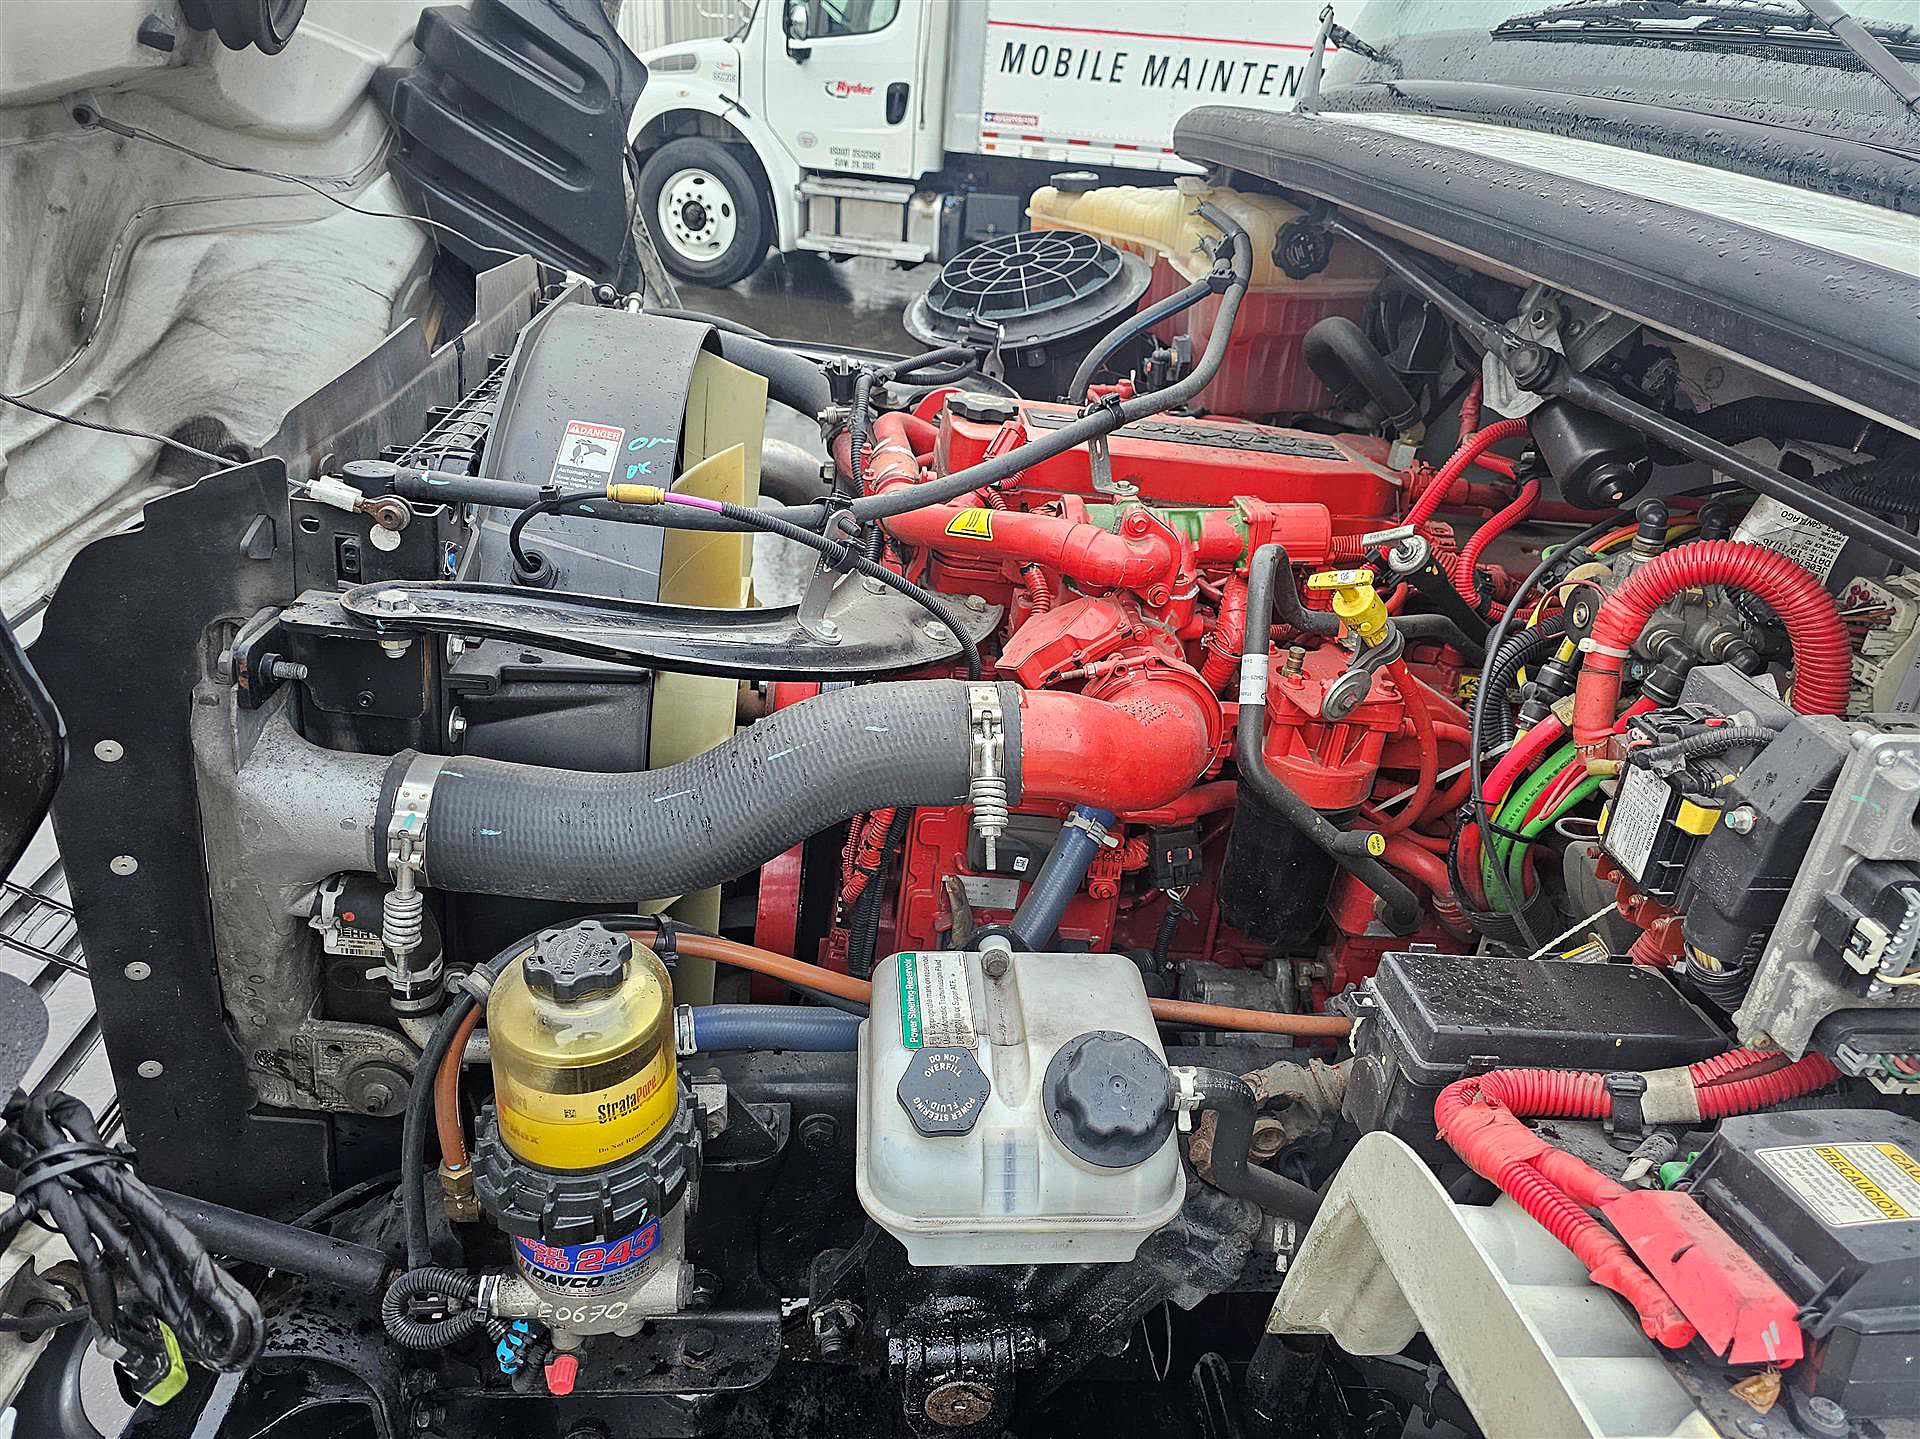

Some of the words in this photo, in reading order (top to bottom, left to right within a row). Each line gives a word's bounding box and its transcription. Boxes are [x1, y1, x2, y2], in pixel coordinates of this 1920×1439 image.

[1000, 42, 1128, 83] MOBILE
[1141, 54, 1326, 97] MAINTEN
[836, 80, 874, 96] Ryder
[580, 427, 620, 441] DANGER
[558, 467, 590, 477] Automatic
[1781, 511, 1822, 530] SANTIAGO
[1652, 814, 1661, 831] MAIN
[903, 959, 915, 989] Reservoir
[936, 972, 946, 1005] Transmission
[905, 991, 918, 1022] Steering
[927, 999, 937, 1029] appropriate
[940, 1006, 948, 1032] Automatic
[909, 1021, 919, 1043] Power
[928, 1054, 941, 1064] DO
[944, 1053, 961, 1064] NOT
[924, 1063, 962, 1078] OVERFILL
[598, 1076, 657, 1123] StrataPore
[913, 1097, 949, 1121] STEERING
[930, 1101, 959, 1112] FLUID
[951, 1097, 976, 1120] POWER
[611, 1141, 624, 1151] Not
[626, 1127, 650, 1145] Remove
[533, 1252, 570, 1272] PRO
[575, 1223, 658, 1273] 243
[531, 1267, 605, 1288] DAVCO
